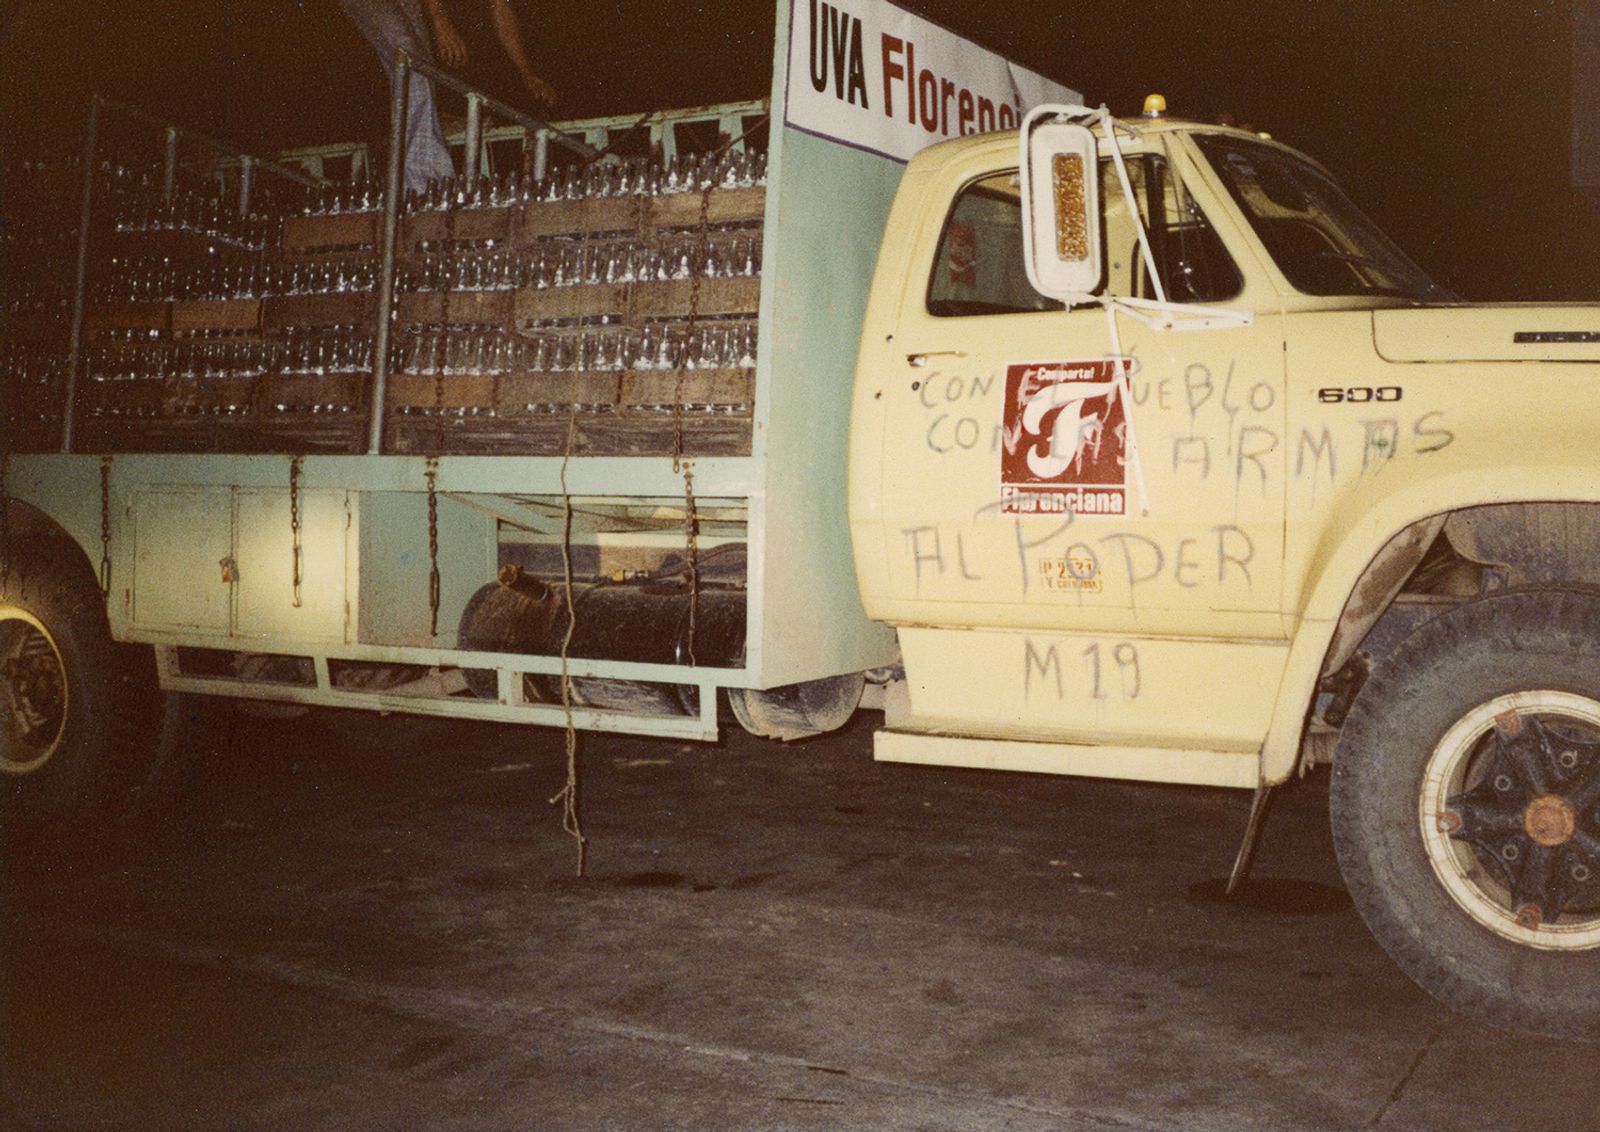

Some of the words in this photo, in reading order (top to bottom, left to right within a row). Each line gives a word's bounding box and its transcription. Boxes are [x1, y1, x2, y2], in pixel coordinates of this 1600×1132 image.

[809, 0, 869, 110] UVA
[920, 370, 994, 408] CON
[1103, 352, 1275, 416] PUEBLO
[1318, 386, 1403, 404] 600
[927, 413, 1022, 455] CON
[1172, 412, 1455, 482] ARMAS
[1002, 485, 1123, 513] Florenciana
[902, 525, 982, 583] AL
[973, 498, 1256, 600] PODER
